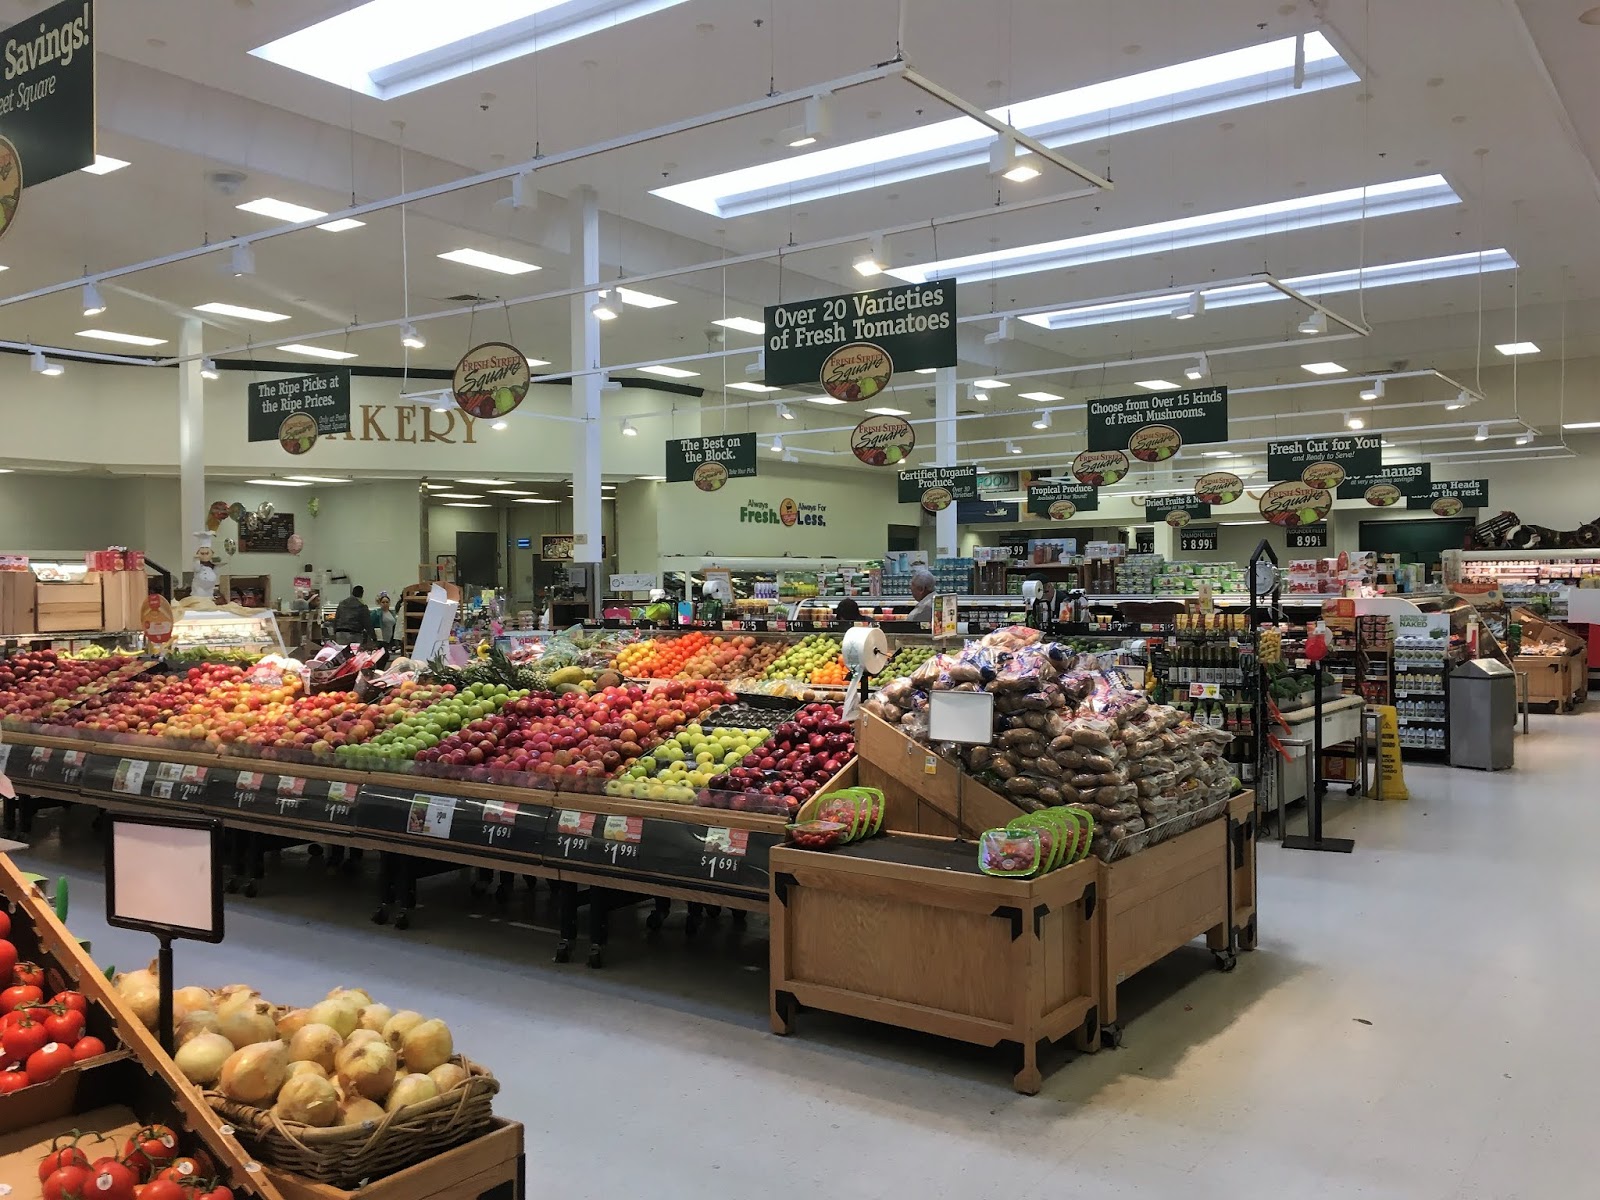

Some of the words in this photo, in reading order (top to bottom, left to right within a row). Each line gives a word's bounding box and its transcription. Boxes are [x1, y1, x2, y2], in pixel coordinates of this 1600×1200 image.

[5, 2, 90, 80] Savings!
[16, 75, 57, 110] Square
[774, 307, 816, 328] Over
[823, 299, 846, 322] 20
[852, 286, 944, 317] Varieties
[770, 328, 790, 350] of
[794, 322, 846, 348] Fresh
[852, 312, 950, 340] Tomatoes
[462, 359, 489, 372] FRESH
[490, 356, 521, 368] STREET
[830, 356, 854, 366] FRESH
[458, 362, 521, 394] Square
[827, 358, 884, 382] Square
[258, 384, 276, 398] The
[278, 380, 300, 396] Ripe
[302, 376, 324, 392] Picks
[326, 376, 340, 389] at
[262, 400, 278, 414] the
[280, 398, 302, 413] Ripe
[304, 394, 335, 409] Prices.
[1091, 401, 1124, 414] Choose
[1126, 400, 1150, 411] from
[1152, 396, 1174, 408] Over
[1178, 394, 1190, 406] 15
[1192, 390, 1222, 404] kinds
[325, 404, 477, 444] KERY
[1106, 412, 1116, 426] of
[1118, 410, 1144, 424] Fresh
[1146, 406, 1206, 422] Mushrooms.
[859, 425, 882, 434] FRESH
[882, 423, 908, 432] STREET
[681, 440, 699, 452] The
[702, 438, 724, 450] Best
[728, 438, 740, 448] on
[855, 428, 908, 448] Square
[1270, 441, 1302, 456] Fresh
[1306, 440, 1328, 453] Cut
[1332, 438, 1351, 451] for
[1354, 436, 1380, 449] You
[685, 452, 702, 464] the
[705, 448, 736, 462] Block.
[1080, 454, 1100, 462] FRESH
[1306, 453, 1325, 462] Ready
[1336, 451, 1356, 459] Serve!
[1076, 456, 1124, 473] Square
[1365, 466, 1422, 478] nanas
[900, 469, 938, 480] Certified
[940, 467, 974, 479] Organic
[977, 476, 1010, 486] FOOD
[918, 478, 954, 488] Produce.
[1031, 486, 1060, 496] Tropical
[1062, 484, 1094, 494] Produce.
[1450, 480, 1480, 489] Heads
[1268, 490, 1293, 498] FRESH
[1461, 488, 1482, 496] rest.
[748, 499, 768, 510] Always
[798, 503, 816, 512] Always
[1146, 498, 1164, 506] Dried
[1165, 496, 1185, 506] Fruits
[1186, 496, 1192, 504] &
[1265, 490, 1323, 512] Square
[740, 506, 780, 524] Fresh.
[797, 510, 826, 526] Less.
[1190, 538, 1210, 550] 8.99
[1296, 536, 1316, 546] 8.99
